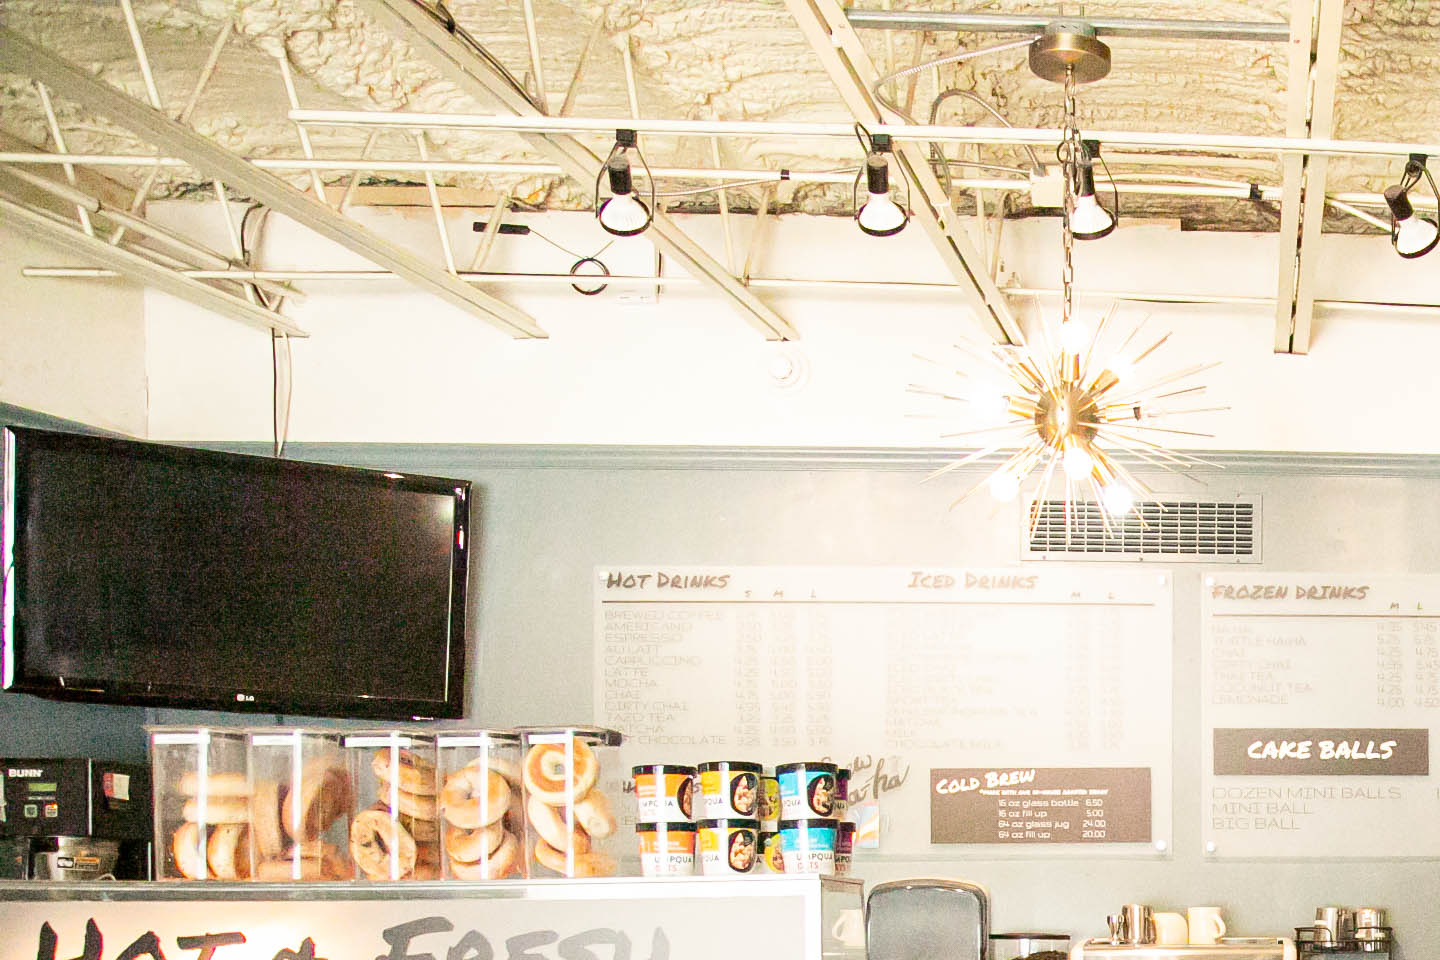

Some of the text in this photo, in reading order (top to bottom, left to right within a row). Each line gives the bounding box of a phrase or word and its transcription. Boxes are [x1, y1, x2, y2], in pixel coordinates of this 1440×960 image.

[607, 572, 731, 589] HOT DRINKS
[908, 571, 1040, 589] ICED DRINKS
[1212, 585, 1370, 600] FROZEN DRINKS
[1389, 602, 1400, 610] M
[1416, 602, 1423, 610] L
[605, 679, 658, 688] MOCHA
[637, 735, 728, 745] CHOCOLATE
[1247, 741, 1398, 759] CAKE BALLS
[10, 768, 45, 778] BUNN
[936, 769, 1036, 794] COLD BREW
[1212, 787, 1281, 800] DOZEN
[1288, 787, 1337, 800] MINI
[1341, 787, 1402, 800] BALLS
[1022, 799, 1049, 808] glass
[1051, 799, 1080, 807] bottle
[1212, 802, 1263, 815] MINI
[1267, 802, 1314, 815] BALL
[1025, 820, 1052, 829] glass
[1054, 820, 1070, 829] jug
[1212, 817, 1250, 830] BIG
[1255, 817, 1302, 830] BALL
[1025, 831, 1036, 839] fill
[1037, 832, 1051, 840] up
[655, 855, 693, 865] UPQUA
[796, 853, 834, 863] UPQUA
